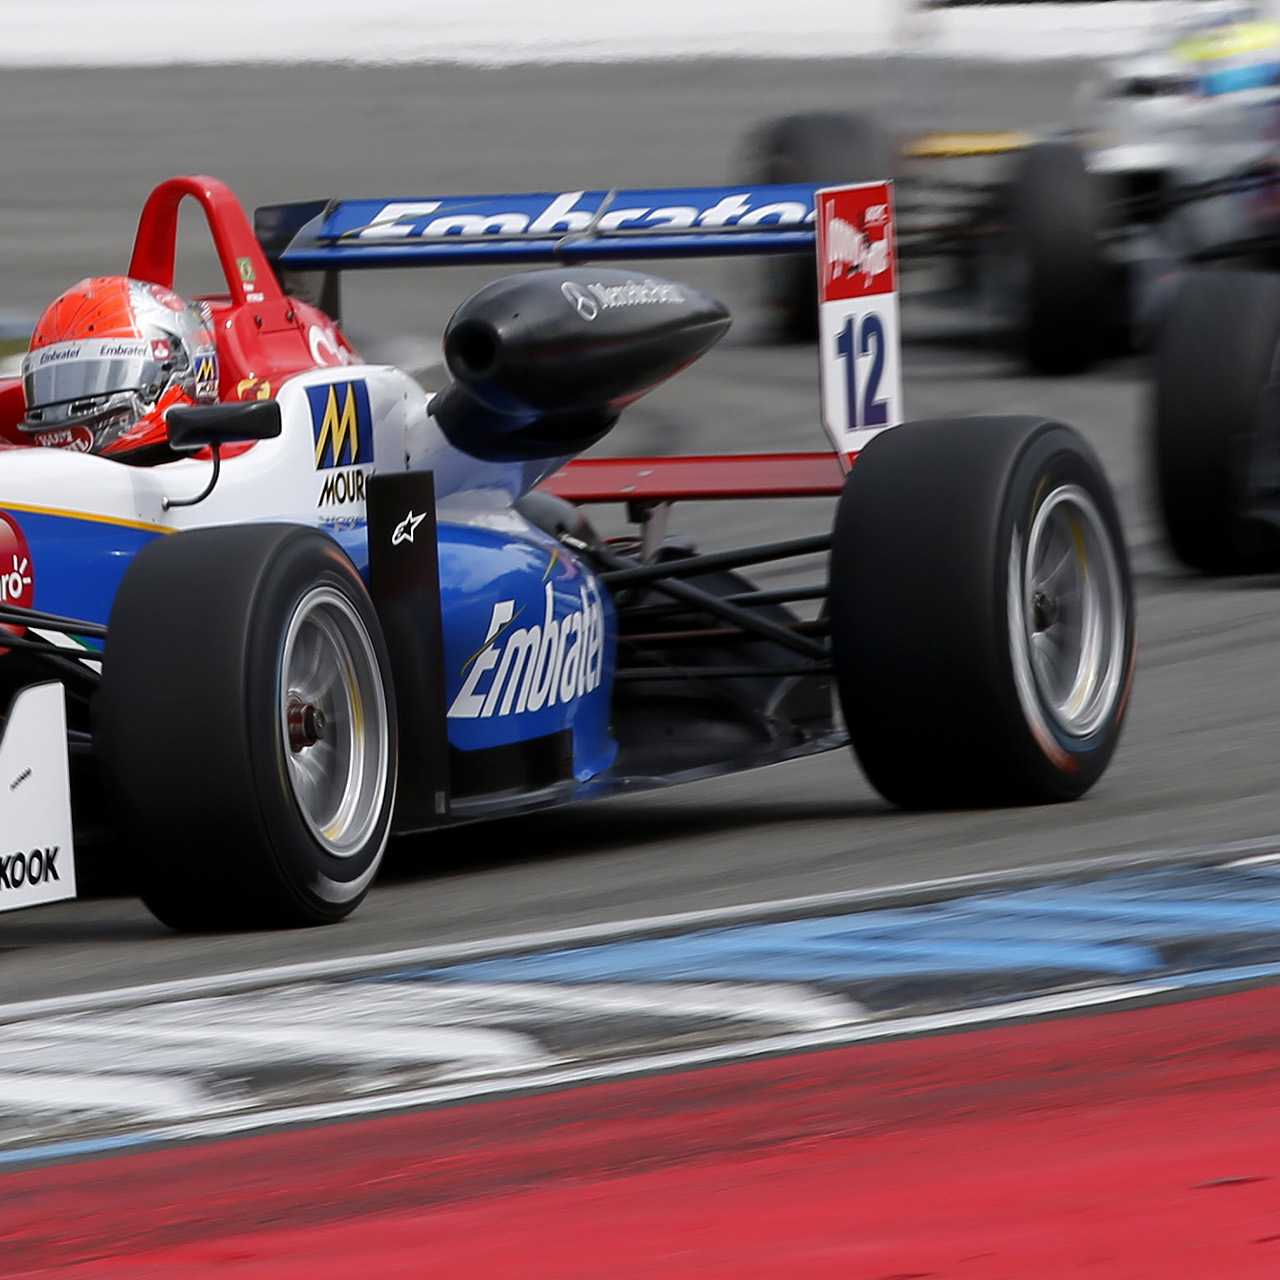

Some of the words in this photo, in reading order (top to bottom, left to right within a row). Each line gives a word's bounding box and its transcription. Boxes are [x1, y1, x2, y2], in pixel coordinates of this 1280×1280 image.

[360, 190, 820, 239] Embrate
[835, 312, 889, 430] 12
[318, 468, 376, 508] MOUR
[446, 578, 604, 717] Embratel
